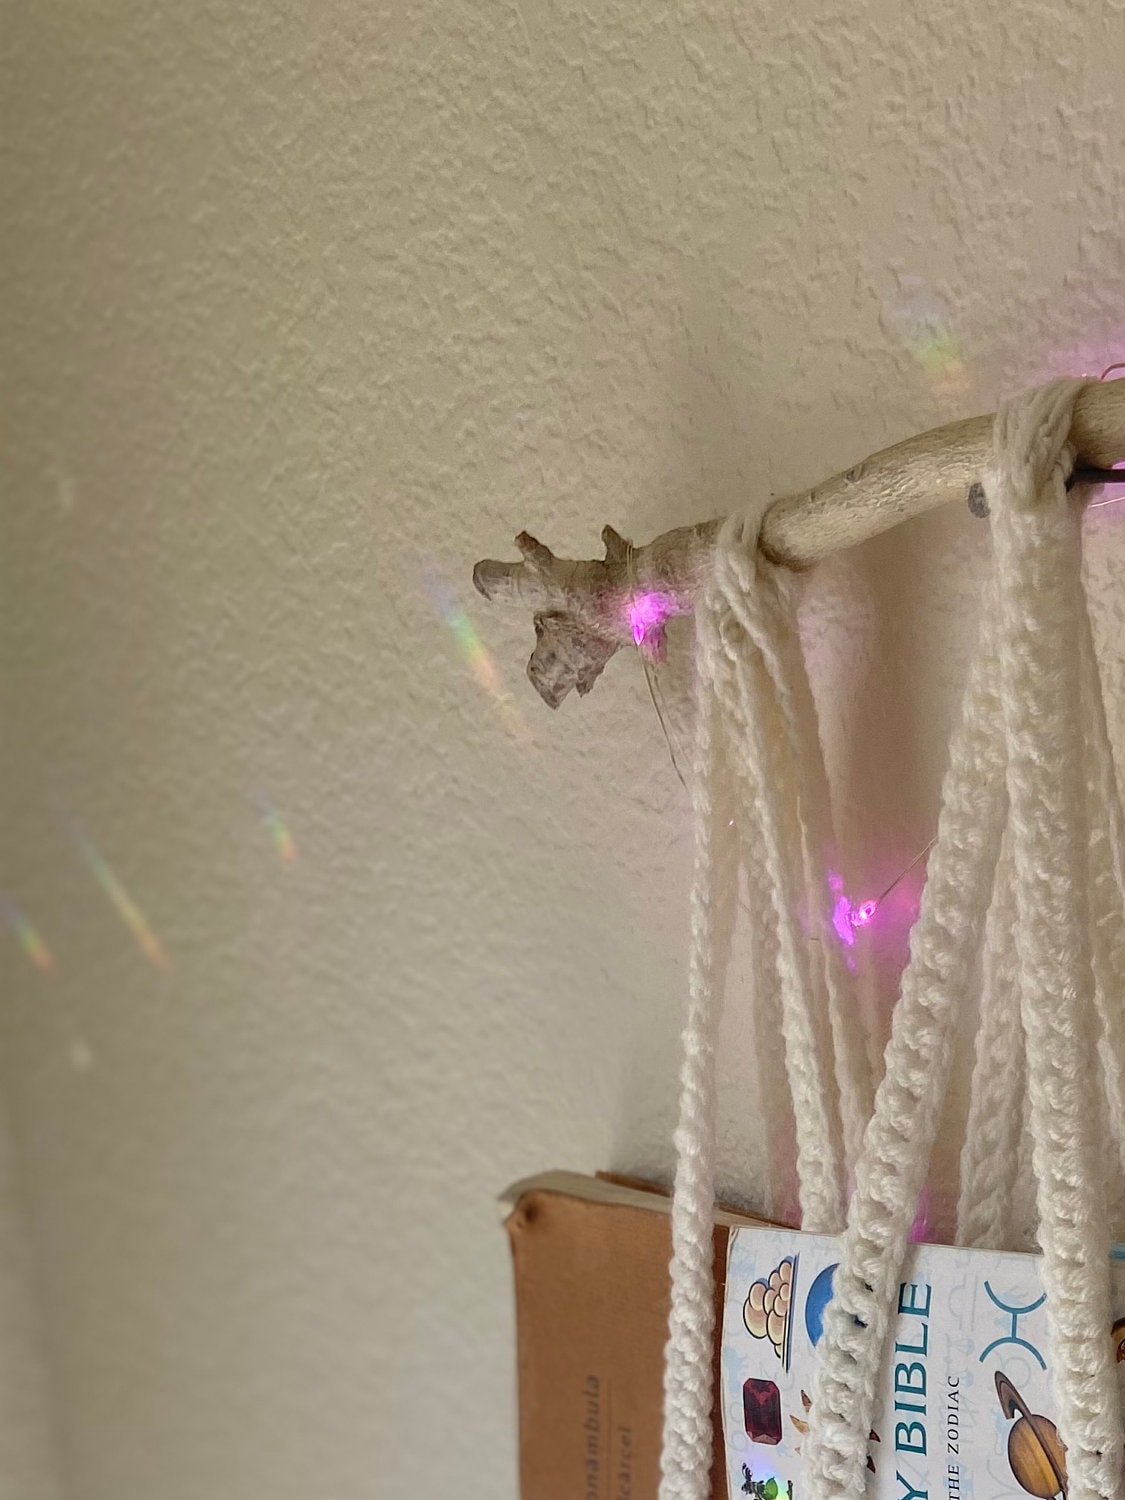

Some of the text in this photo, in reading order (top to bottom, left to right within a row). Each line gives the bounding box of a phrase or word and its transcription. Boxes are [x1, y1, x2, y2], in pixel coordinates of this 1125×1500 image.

[894, 1281, 932, 1456] BIBLE
[947, 1375, 960, 1455] ZODIAC
[947, 1464, 960, 1500] THE
